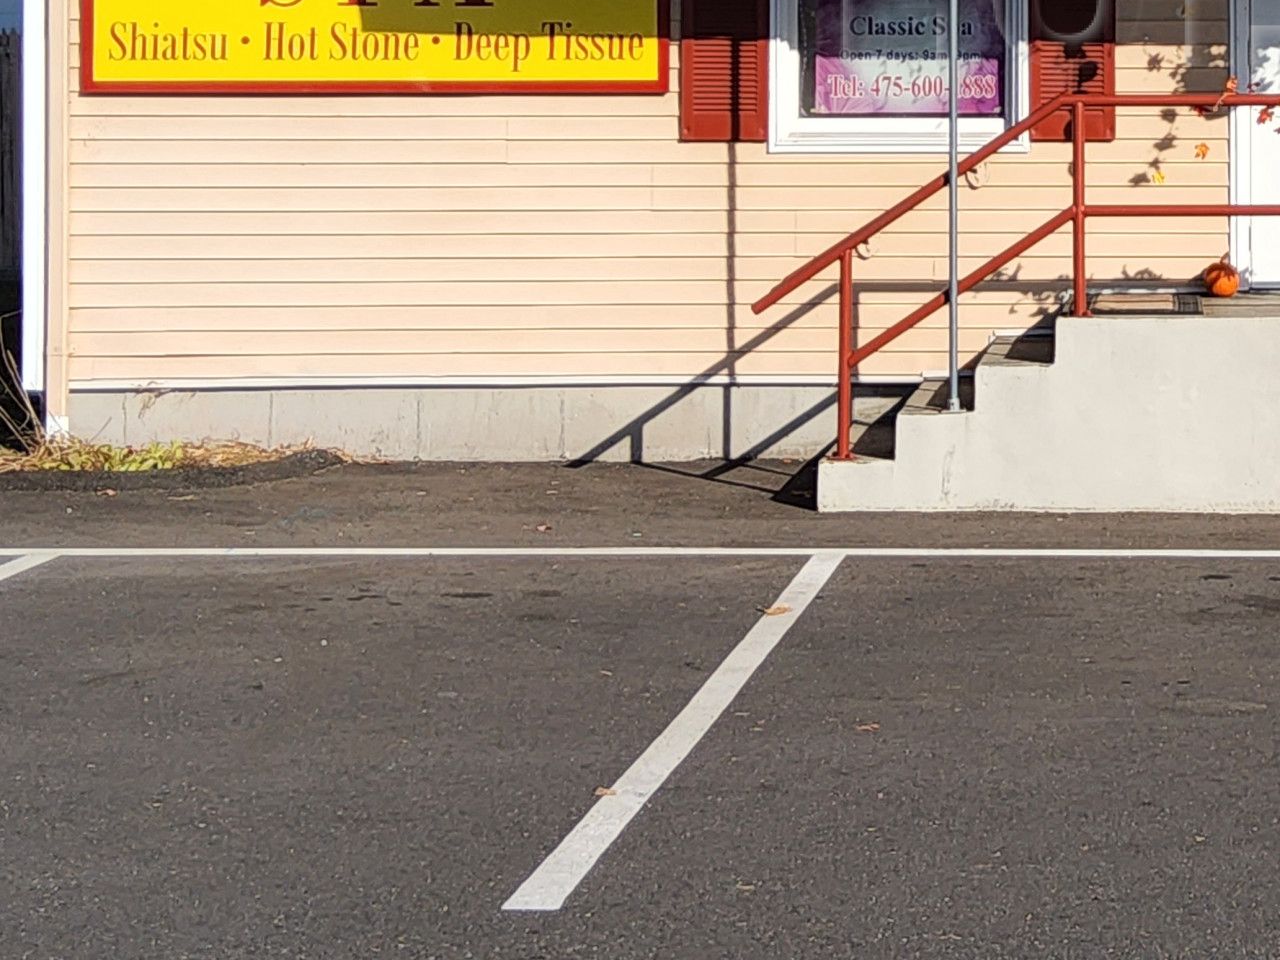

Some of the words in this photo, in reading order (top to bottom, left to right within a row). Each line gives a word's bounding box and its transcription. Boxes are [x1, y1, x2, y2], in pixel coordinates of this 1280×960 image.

[849, 15, 925, 35] Classic
[932, 15, 973, 36] Sa
[108, 21, 228, 61] Shiatsu
[262, 22, 319, 61] Hot
[328, 21, 420, 61] Stone
[453, 22, 530, 72] Deep
[541, 22, 645, 61] Tissue
[827, 73, 864, 98] Tel:
[871, 74, 996, 98] 475-600-888
